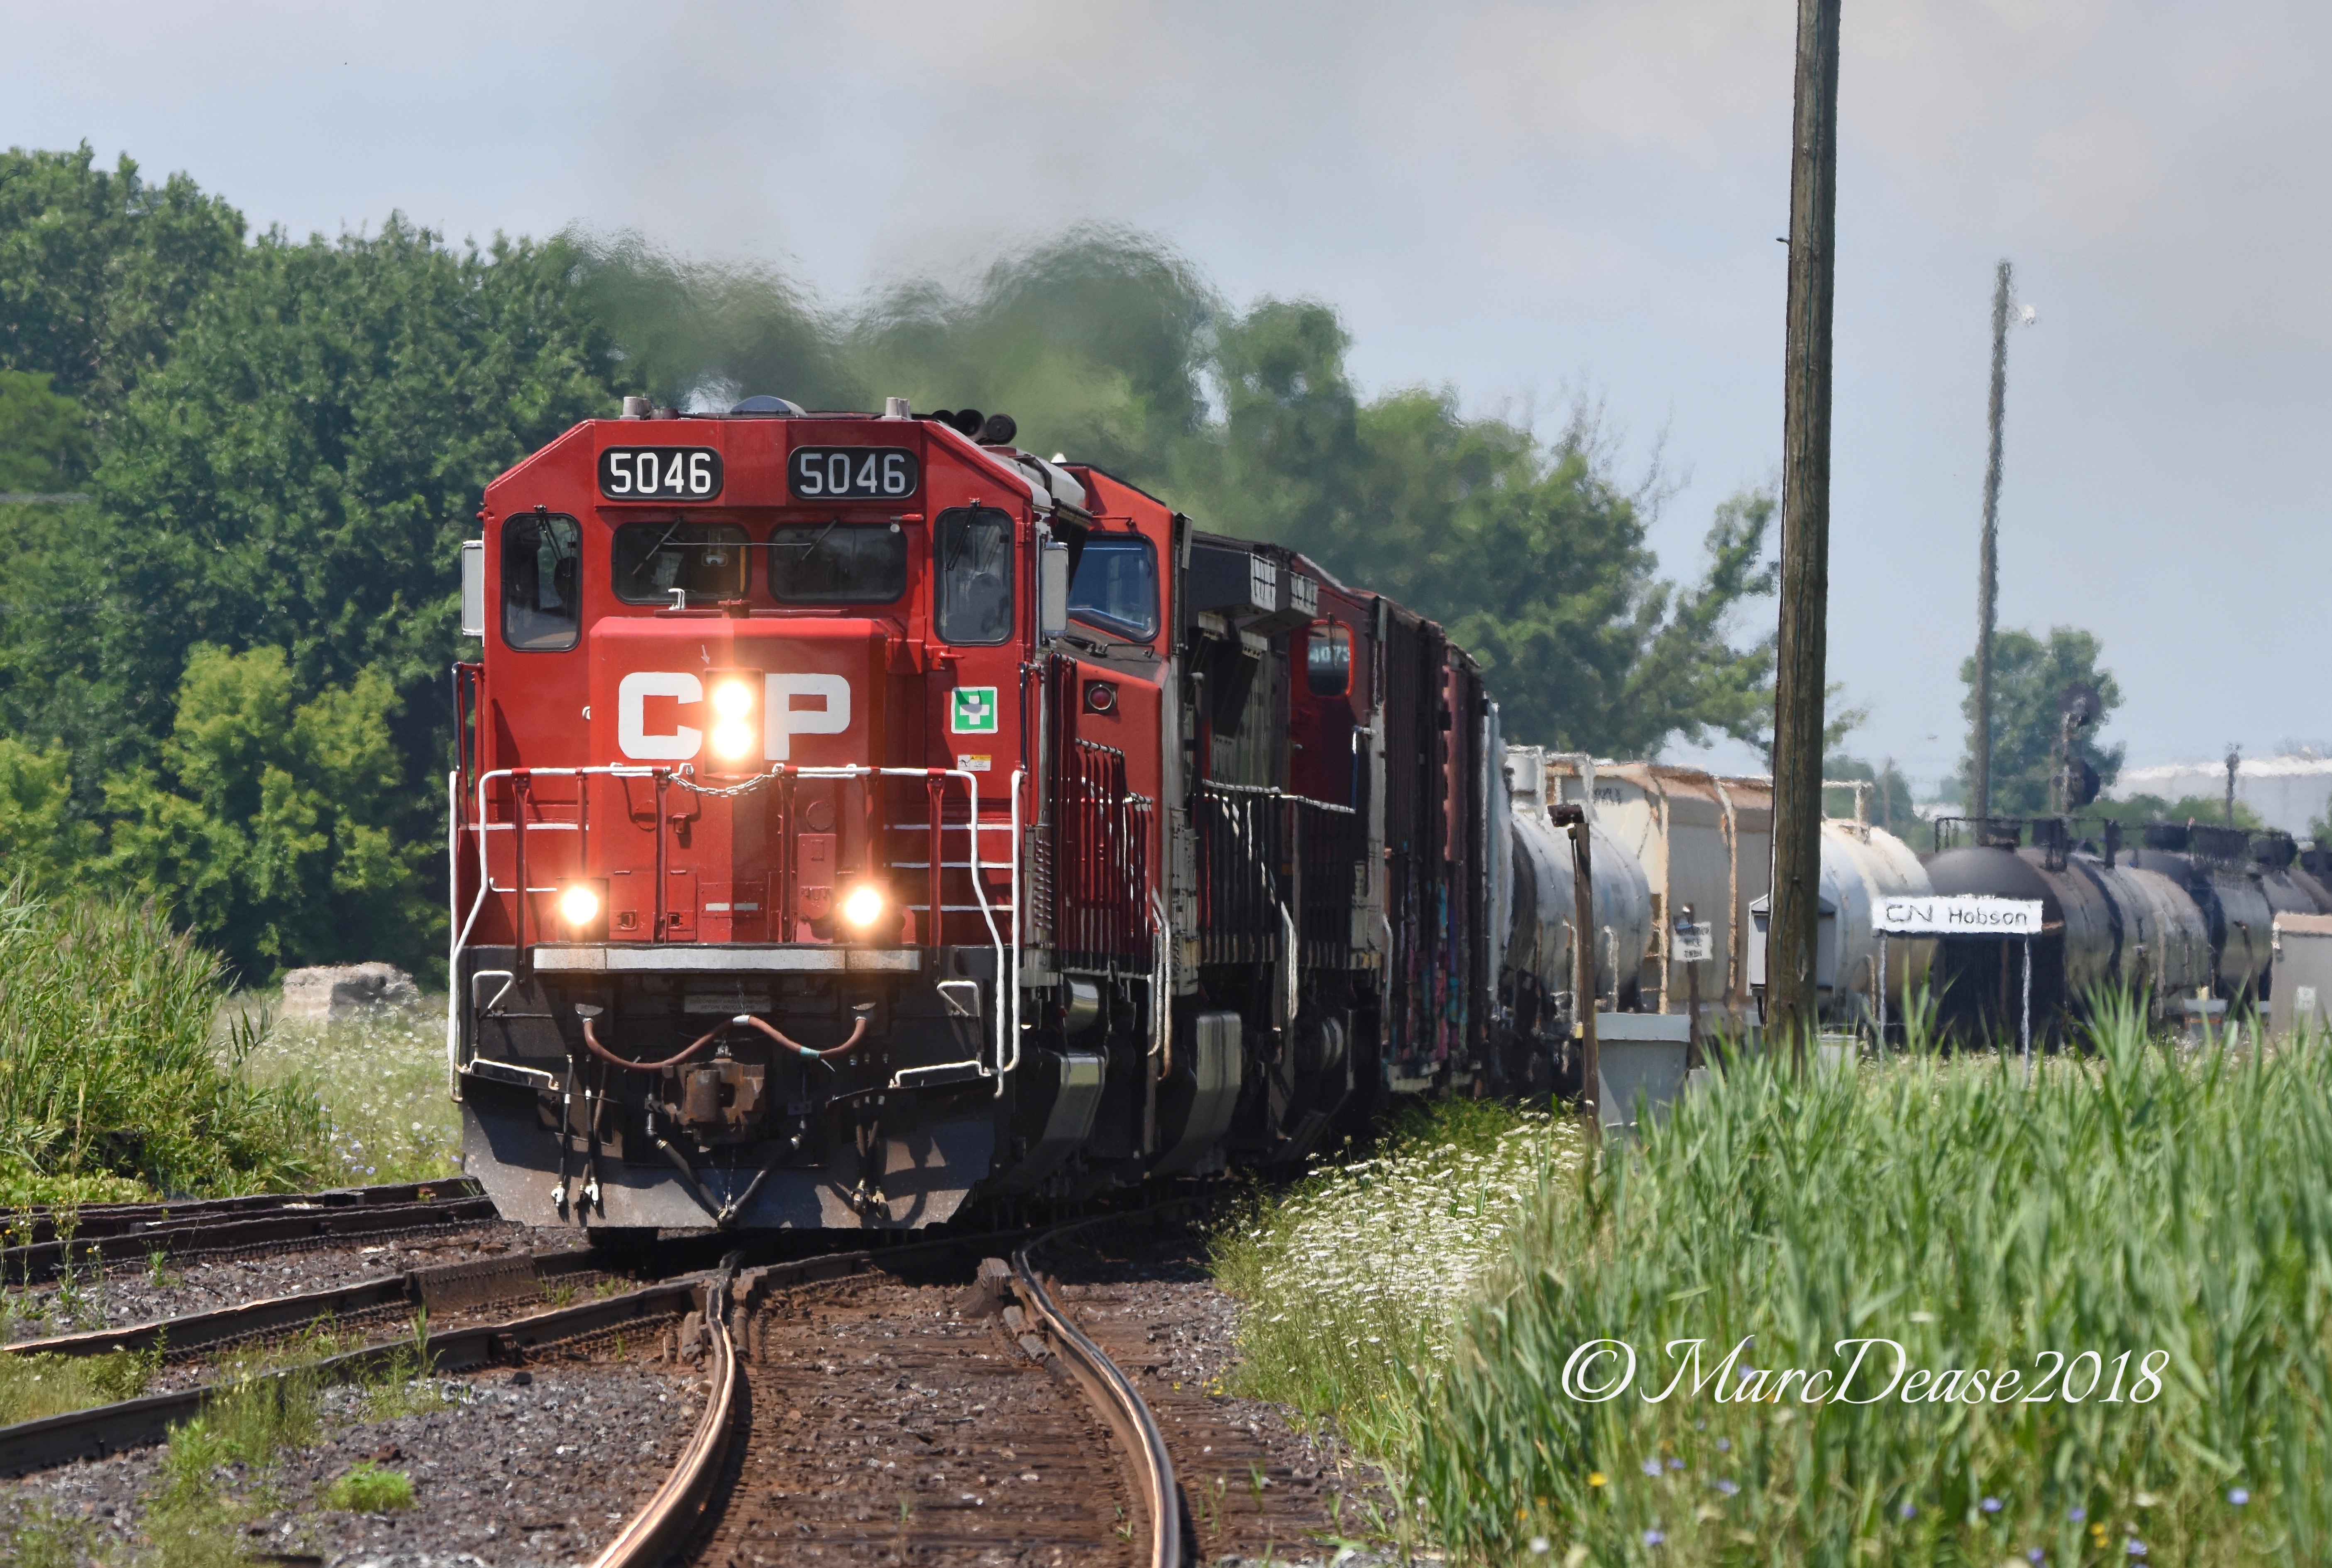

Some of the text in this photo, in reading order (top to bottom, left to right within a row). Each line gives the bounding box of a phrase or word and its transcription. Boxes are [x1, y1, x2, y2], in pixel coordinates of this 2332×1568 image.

[610, 452, 710, 493] 5046
[799, 453, 905, 494] 5046
[618, 672, 851, 761] CP
[1887, 904, 2027, 926] CN Hobson
